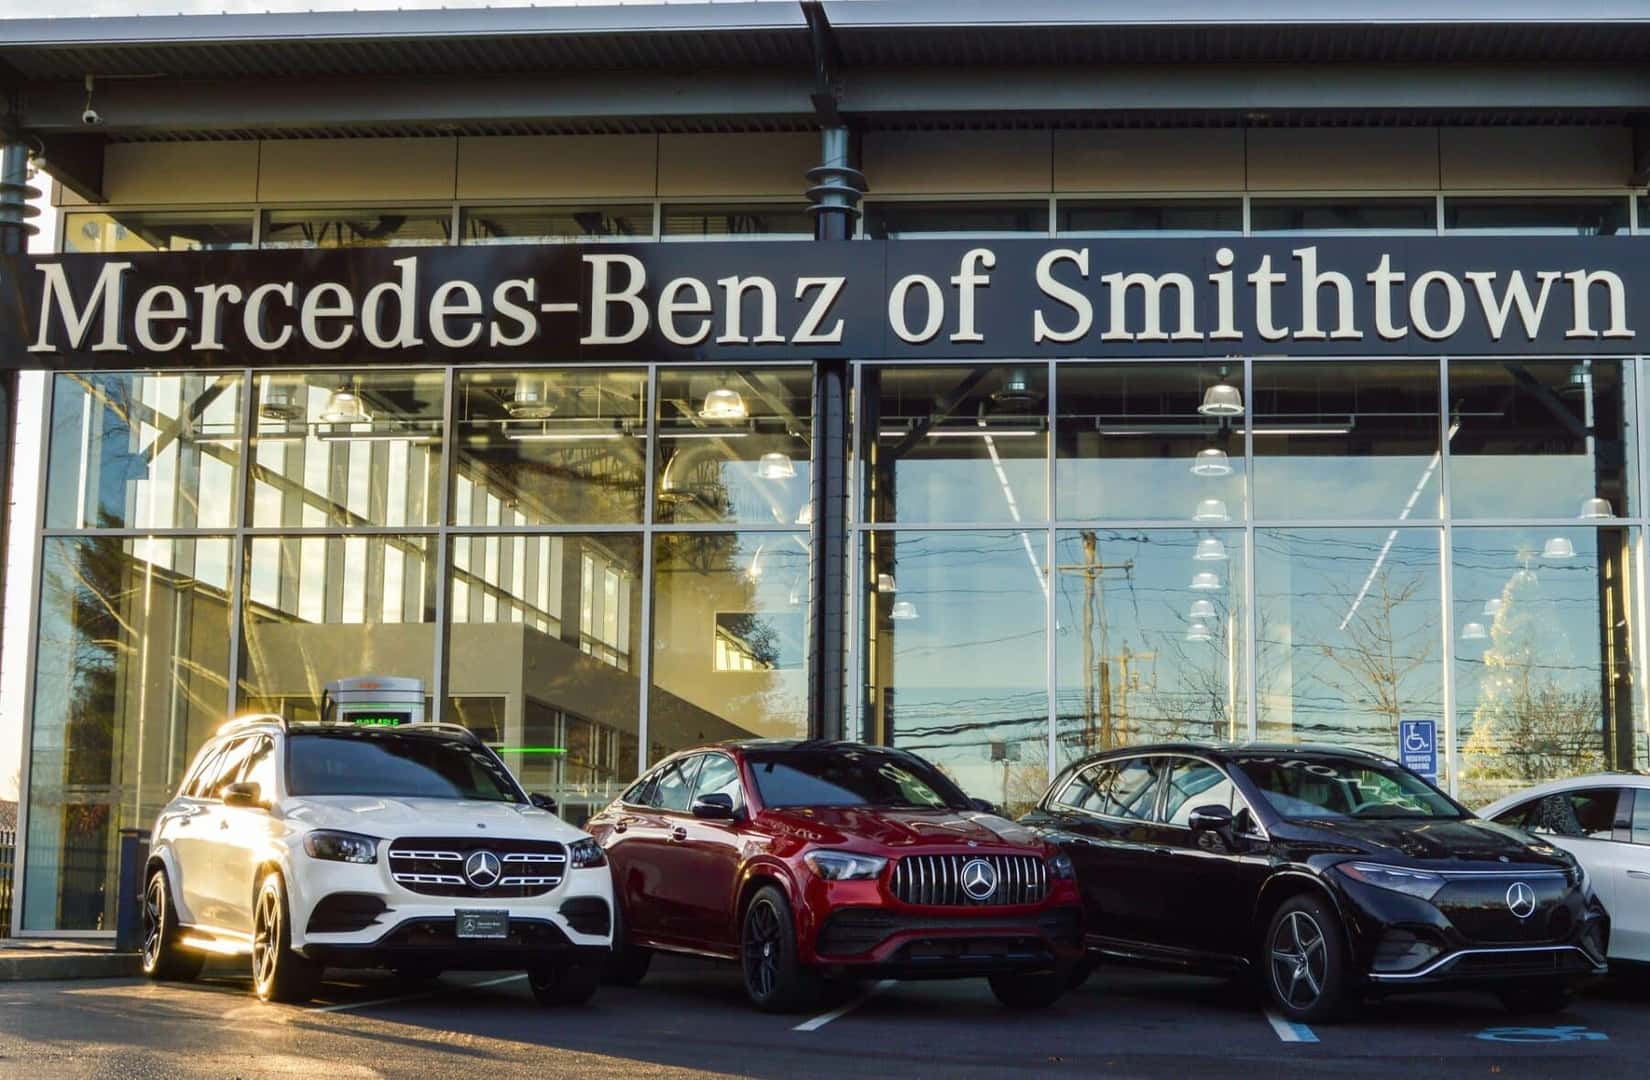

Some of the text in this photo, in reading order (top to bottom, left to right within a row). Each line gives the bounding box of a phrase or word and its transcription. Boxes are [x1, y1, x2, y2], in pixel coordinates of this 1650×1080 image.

[27, 246, 1636, 353] Mercedes-Benz of Smithtown
